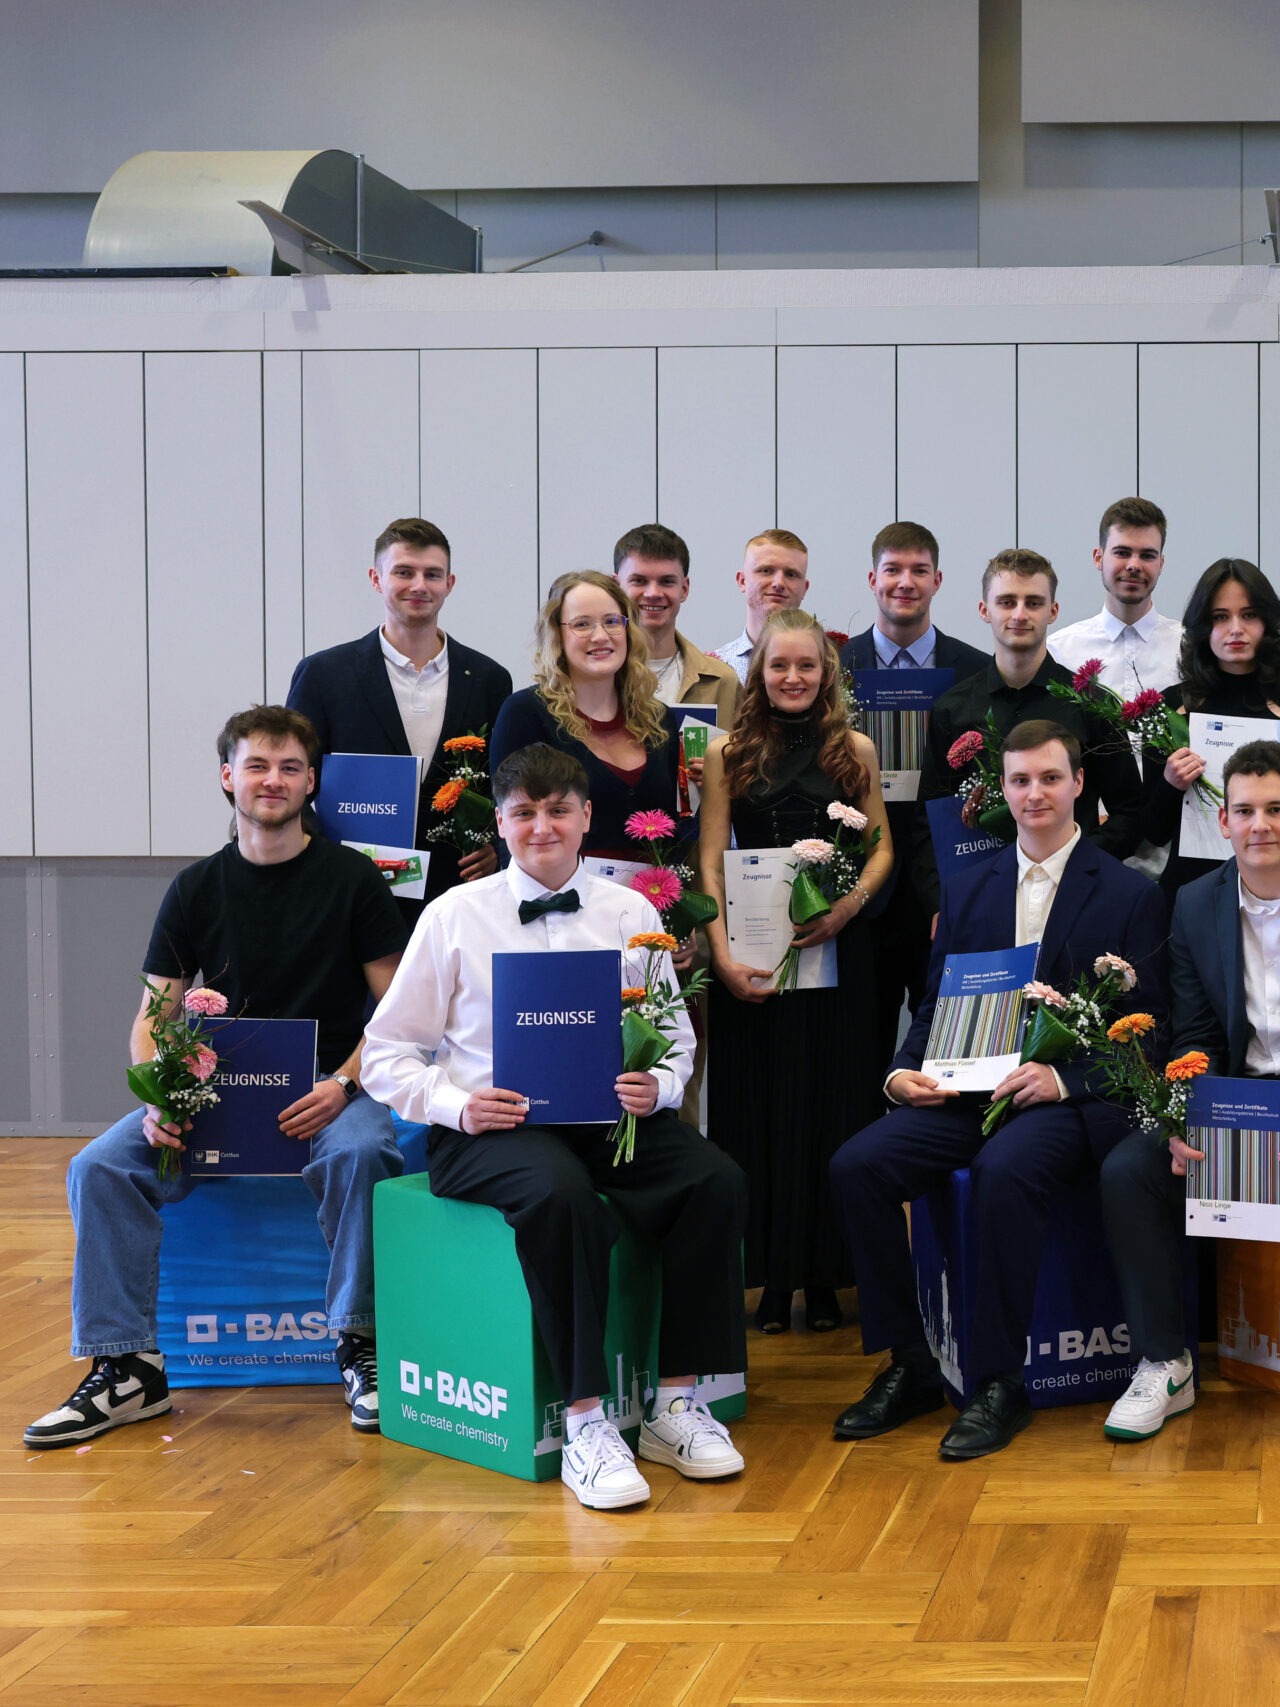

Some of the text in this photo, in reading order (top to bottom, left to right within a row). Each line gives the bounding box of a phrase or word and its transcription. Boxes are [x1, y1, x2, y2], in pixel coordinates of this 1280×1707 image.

[337, 802, 398, 815] ZEUGNISSE
[742, 873, 773, 882] Zeugnisse
[516, 1010, 596, 1026] ZEUGNISSE
[212, 1073, 291, 1086] ZEUGNISSE
[1200, 1200, 1231, 1210] Nico Linge
[1059, 1323, 1131, 1361] BAS
[187, 1351, 337, 1366] We create chemist
[1032, 1363, 1139, 1391] create chemis
[436, 1369, 508, 1420] BASF
[401, 1403, 509, 1452] We create chemistry
